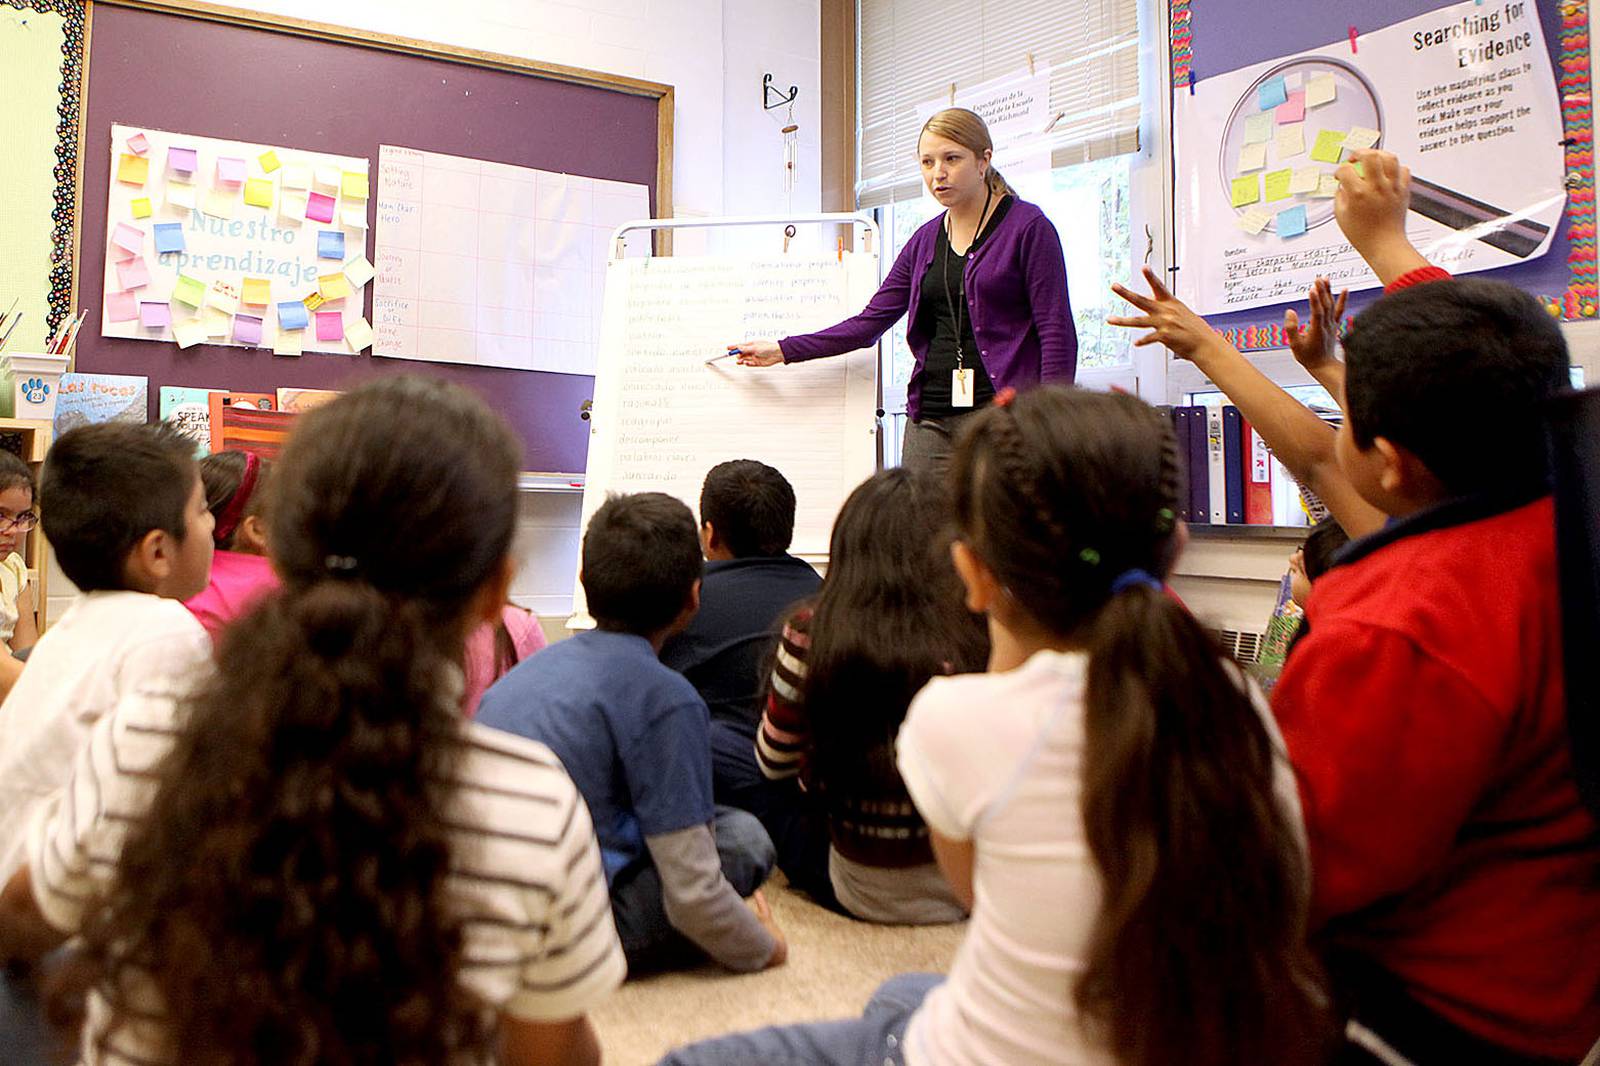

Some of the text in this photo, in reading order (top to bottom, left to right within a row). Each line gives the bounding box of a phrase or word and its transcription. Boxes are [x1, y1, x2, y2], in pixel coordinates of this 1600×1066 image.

[1413, 2, 1524, 51] Searching for
[1458, 31, 1531, 68] Evidence
[1417, 63, 1531, 100] Use the magnifying glass to
[1417, 83, 1513, 112] collect evidence as you
[1419, 106, 1531, 139] evidence helps support the
[1440, 109, 1461, 121] Make
[1463, 104, 1482, 116] sure
[1484, 99, 1504, 112] your
[1419, 139, 1447, 152] answer
[1449, 136, 1459, 147] to
[1460, 132, 1474, 144] the
[190, 208, 296, 244] Nuestro
[158, 250, 318, 287] aprendizaje
[1256, 255, 1298, 267] character
[32, 392, 42, 400] 23
